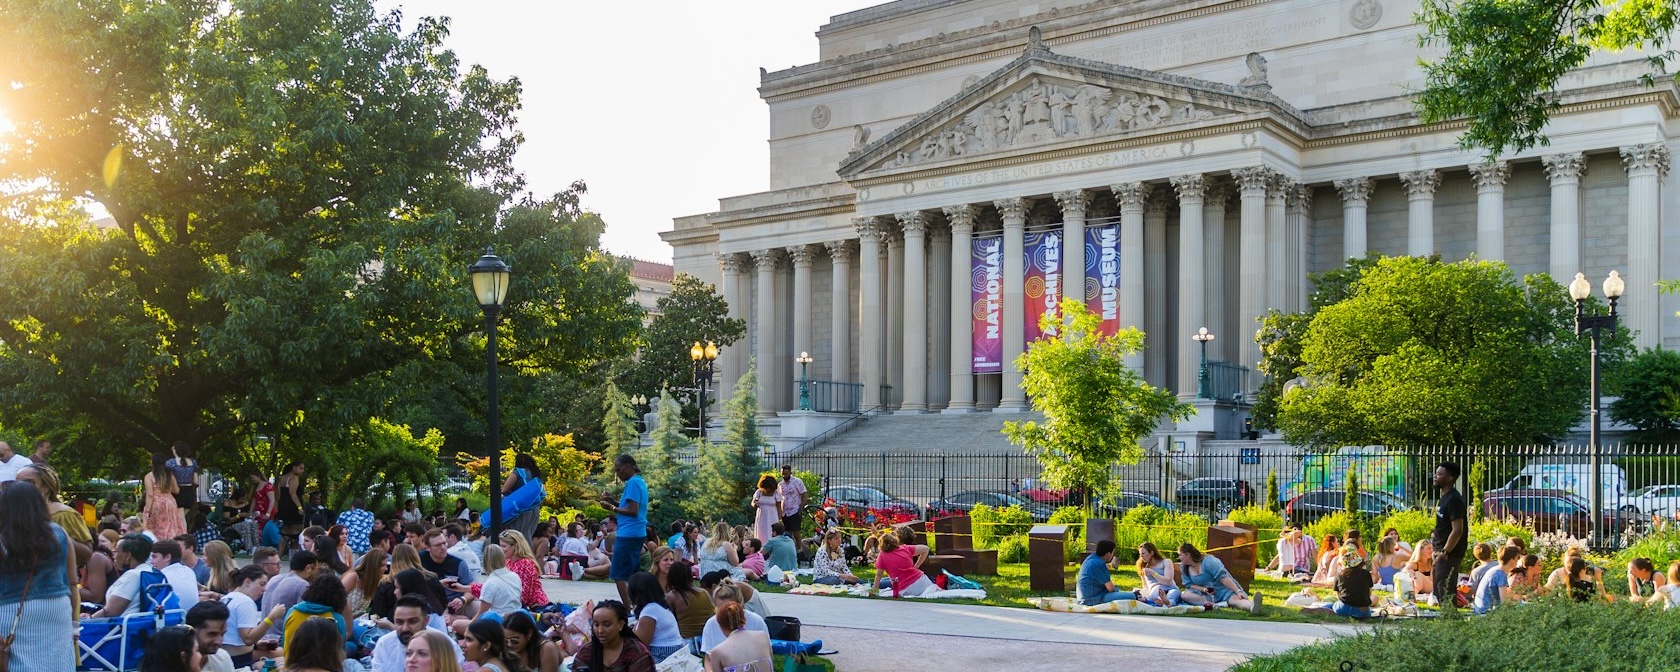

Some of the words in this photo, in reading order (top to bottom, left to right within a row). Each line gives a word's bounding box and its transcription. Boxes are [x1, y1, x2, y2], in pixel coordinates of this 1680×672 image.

[1124, 43, 1139, 53] THE
[1166, 36, 1177, 46] OF
[1180, 31, 1197, 42] OUR
[1246, 18, 1266, 30] ONE
[1162, 48, 1203, 63] BUILDING
[1164, 44, 1181, 54] THE
[1182, 35, 1224, 51] ARCHIVES
[1229, 32, 1239, 42] OF
[1241, 29, 1259, 40] OUR
[1263, 16, 1327, 36] GOVERNMENT
[923, 174, 973, 191] ARCHIVES
[974, 171, 988, 184] OF
[991, 168, 1009, 182] THE
[1012, 162, 1052, 179] UNITED
[1056, 156, 1093, 173] STATES
[1096, 153, 1111, 167] OF
[1112, 146, 1169, 165] AMERICA
[986, 240, 1000, 339] NATIONAL
[1101, 228, 1117, 320] MUSEUM
